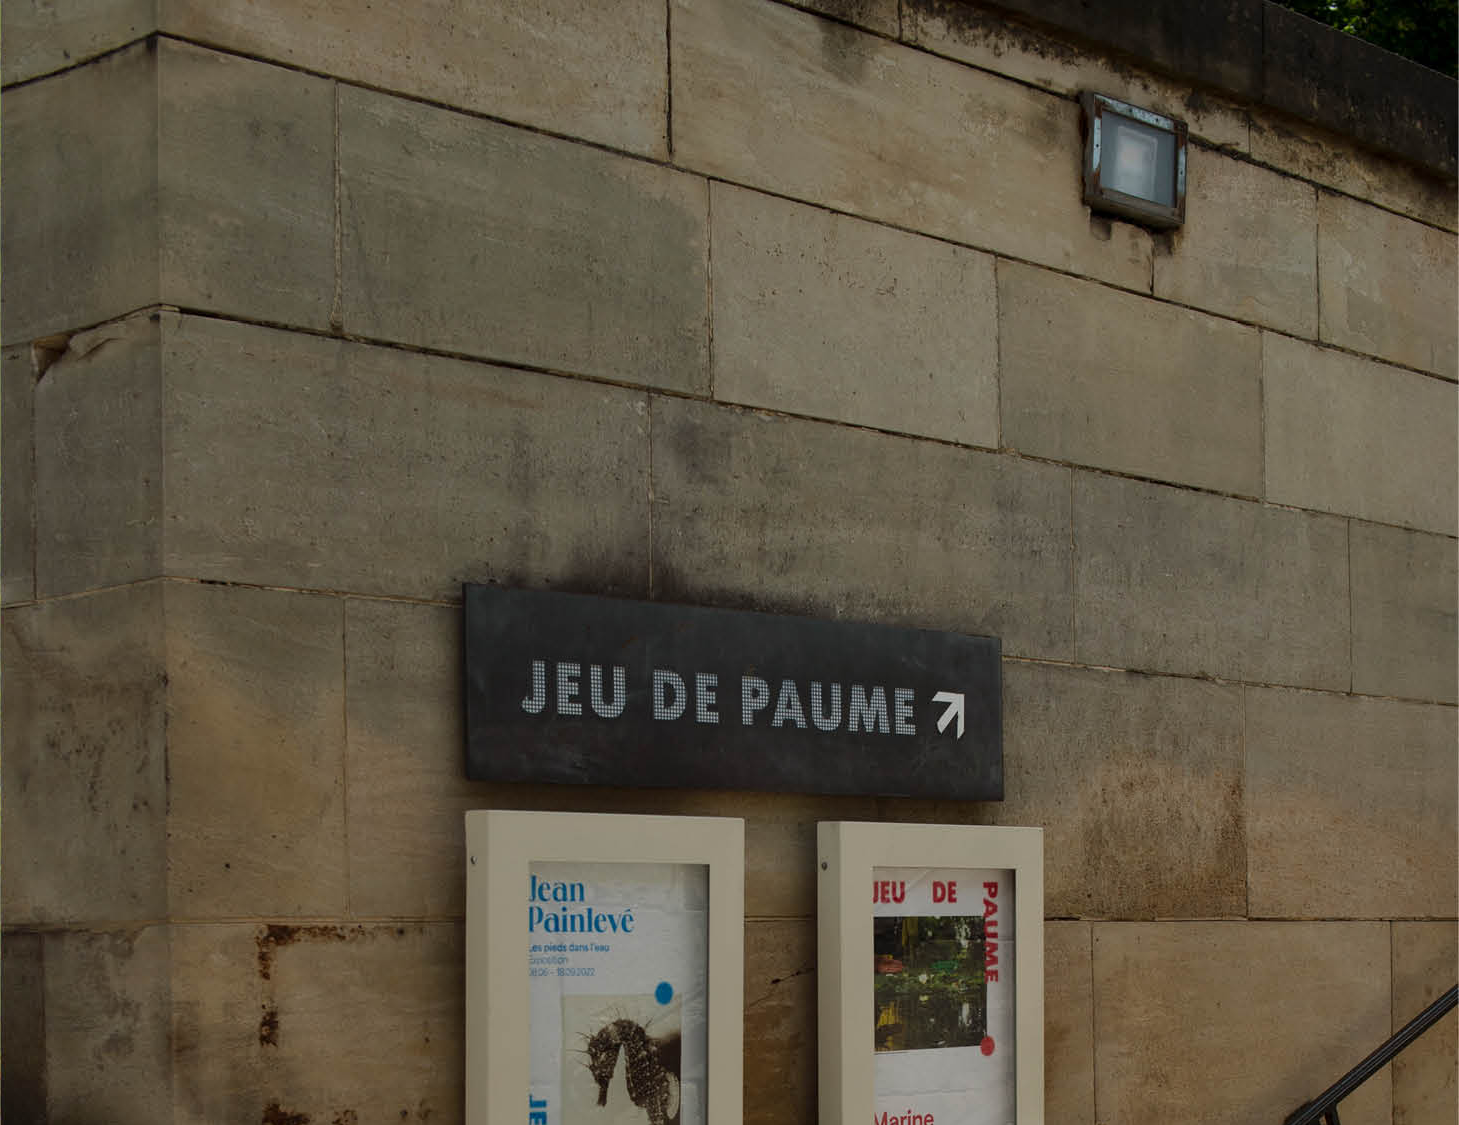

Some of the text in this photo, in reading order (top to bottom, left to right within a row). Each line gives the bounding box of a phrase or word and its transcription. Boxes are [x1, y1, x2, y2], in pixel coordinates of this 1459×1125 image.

[521, 660, 917, 735] JEU DE PAUME
[529, 875, 585, 902] Jean
[873, 880, 957, 904] JEU DE
[528, 905, 635, 934] Painlevé
[983, 881, 999, 984] PAUME
